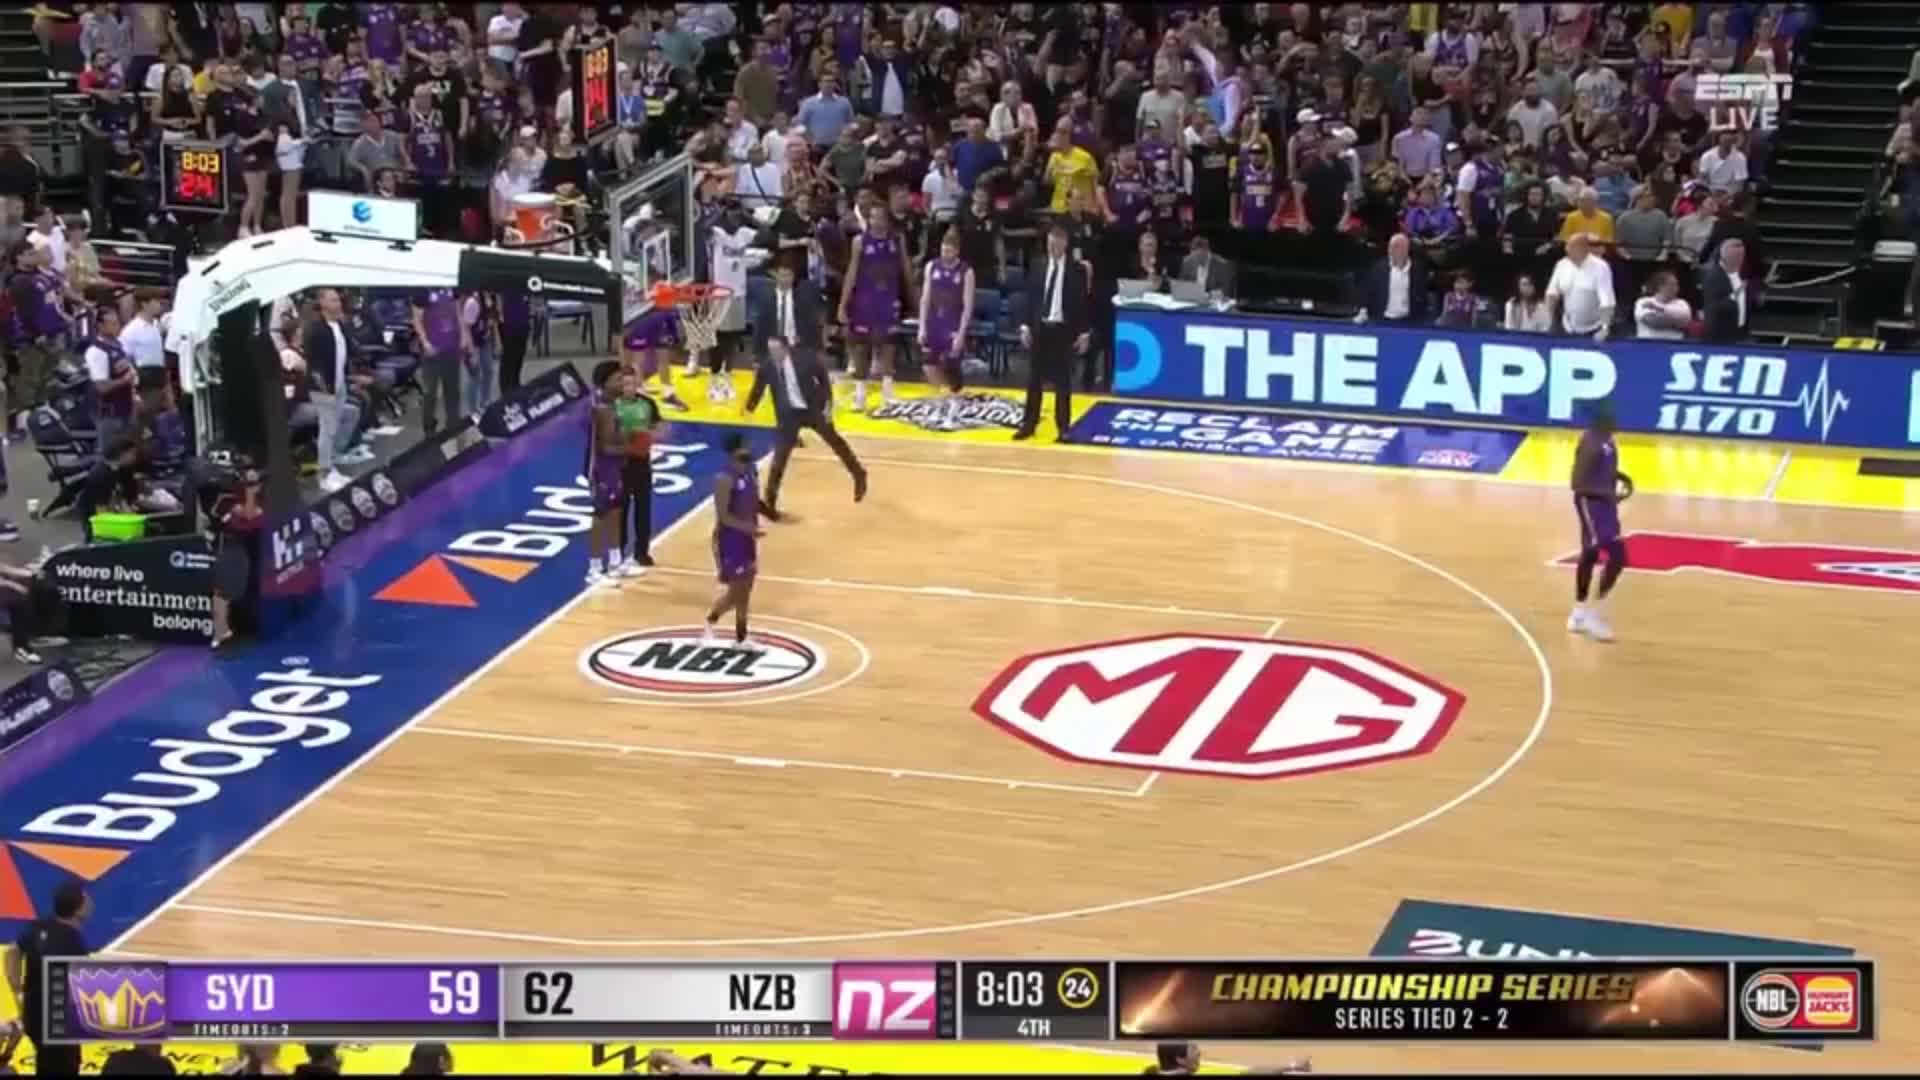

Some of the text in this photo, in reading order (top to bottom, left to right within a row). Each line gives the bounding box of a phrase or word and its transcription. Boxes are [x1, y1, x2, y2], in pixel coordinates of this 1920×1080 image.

[181, 151, 220, 173] 8:03
[180, 173, 215, 199] 24
[1184, 325, 1379, 406] THE
[1400, 339, 1618, 420] APP
[1665, 352, 1788, 396] SEN
[1115, 408, 1399, 439] RECLAIM
[1656, 403, 1777, 435] 1170
[1110, 420, 1389, 454] THE GAME
[56, 561, 144, 583] where live
[630, 642, 767, 676] NBL
[1019, 646, 1418, 764] MG
[20, 668, 383, 841] Budget
